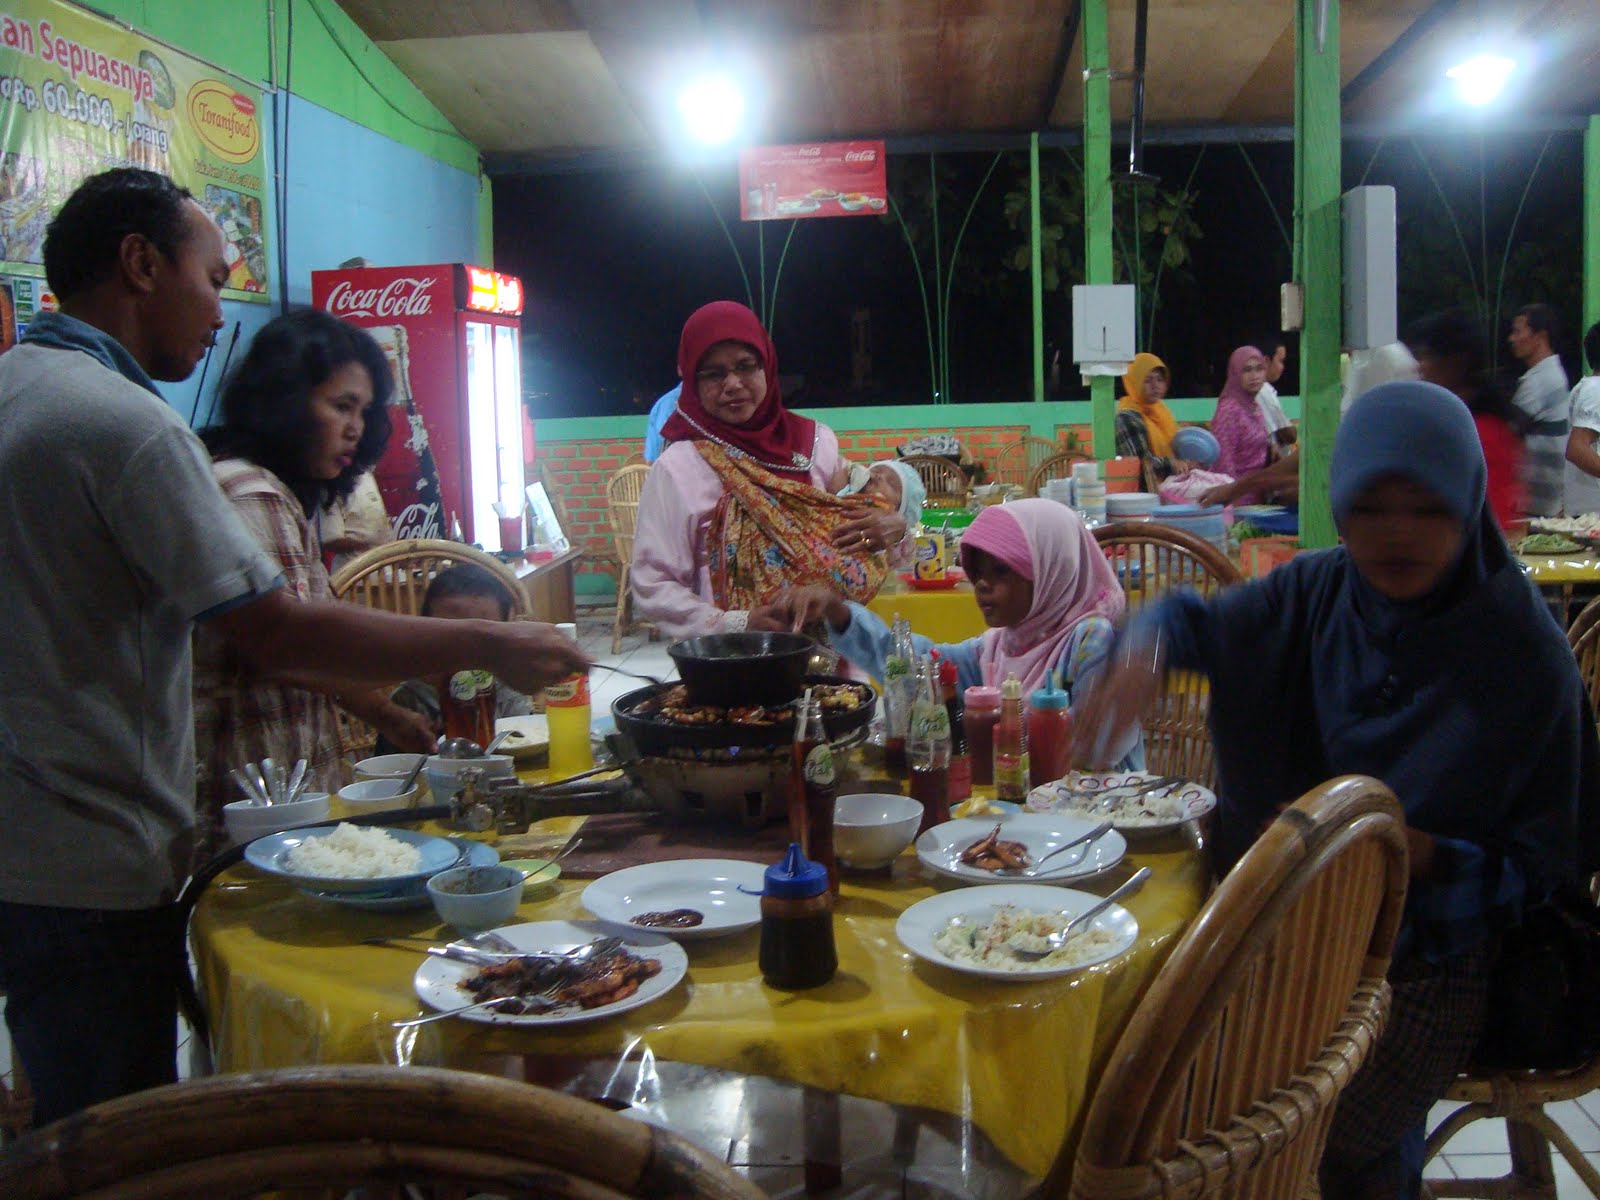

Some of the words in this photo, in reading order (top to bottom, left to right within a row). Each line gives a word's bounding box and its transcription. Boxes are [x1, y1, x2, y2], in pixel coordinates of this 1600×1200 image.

[0, 17, 34, 54] an
[39, 21, 153, 102] Sepuasnya
[846, 150, 876, 161] Coca-Cola
[325, 277, 437, 318] Coca-Cola
